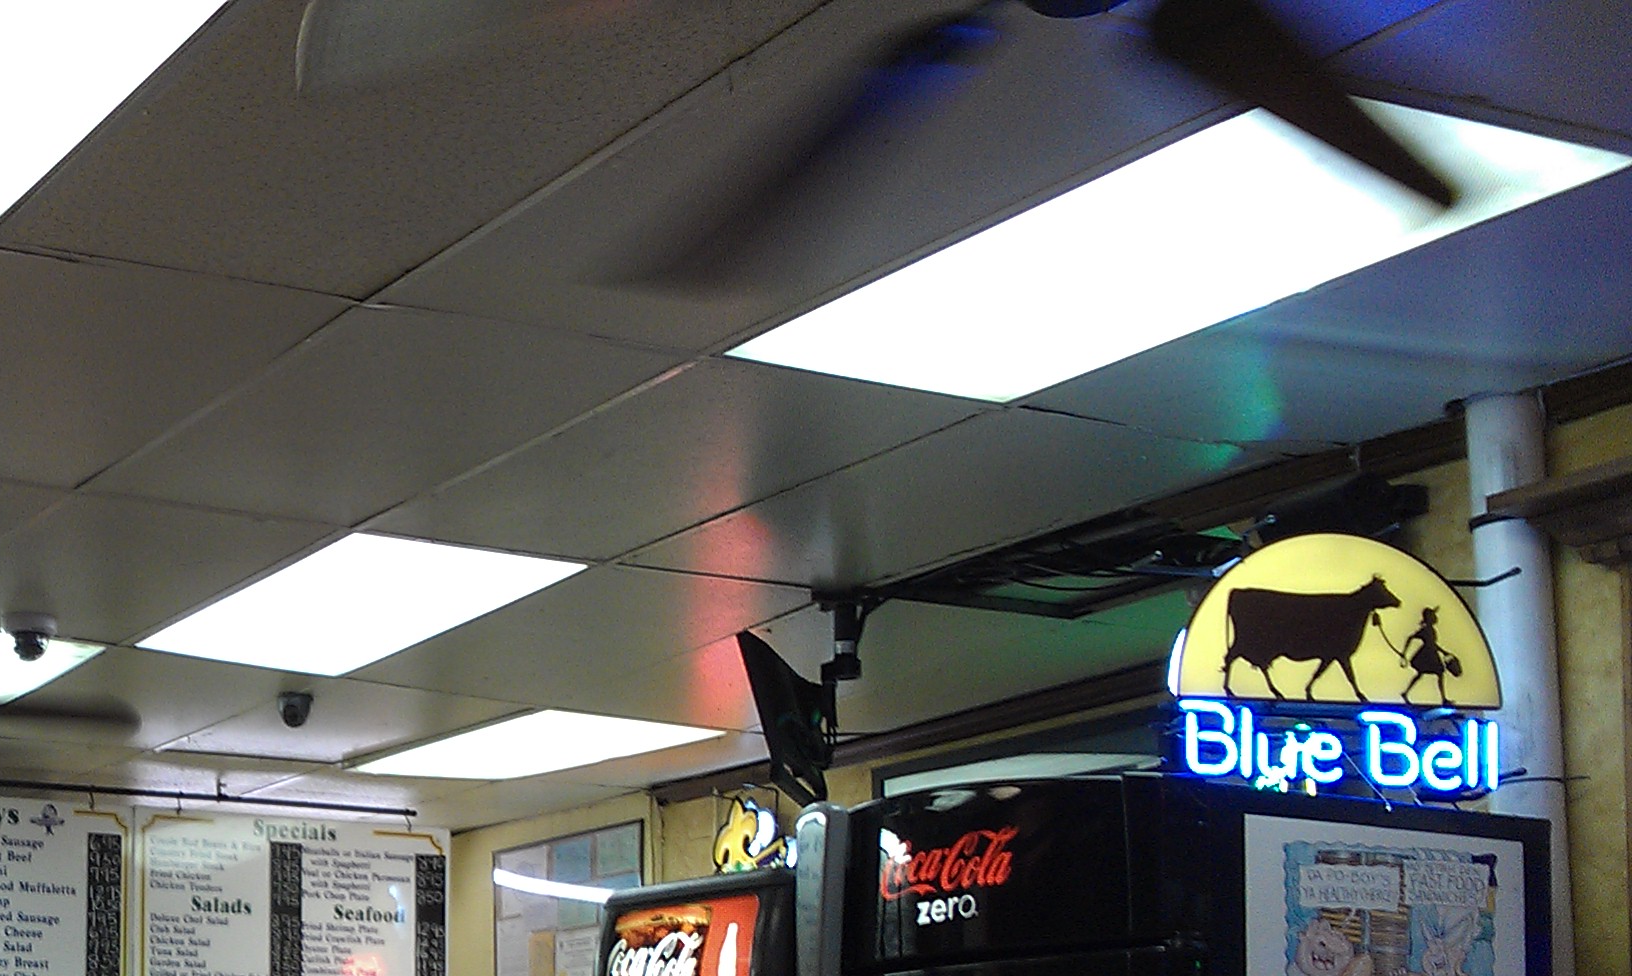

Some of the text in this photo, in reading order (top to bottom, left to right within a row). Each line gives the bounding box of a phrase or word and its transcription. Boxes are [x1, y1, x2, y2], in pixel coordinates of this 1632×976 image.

[1179, 699, 1500, 790] Blue Bell
[253, 819, 337, 842] Specials
[1, 835, 44, 850] Sausage
[8, 852, 32, 863] Beef
[880, 825, 1019, 900] Coca-Cola
[19, 881, 76, 895] Muffaletta
[192, 896, 251, 914] Salads
[916, 895, 976, 926] zero
[18, 911, 60, 926] Sausage
[334, 904, 405, 923] Seafood
[4, 926, 43, 938] Cheese
[3, 941, 32, 952] Salad
[15, 956, 48, 969] Breast
